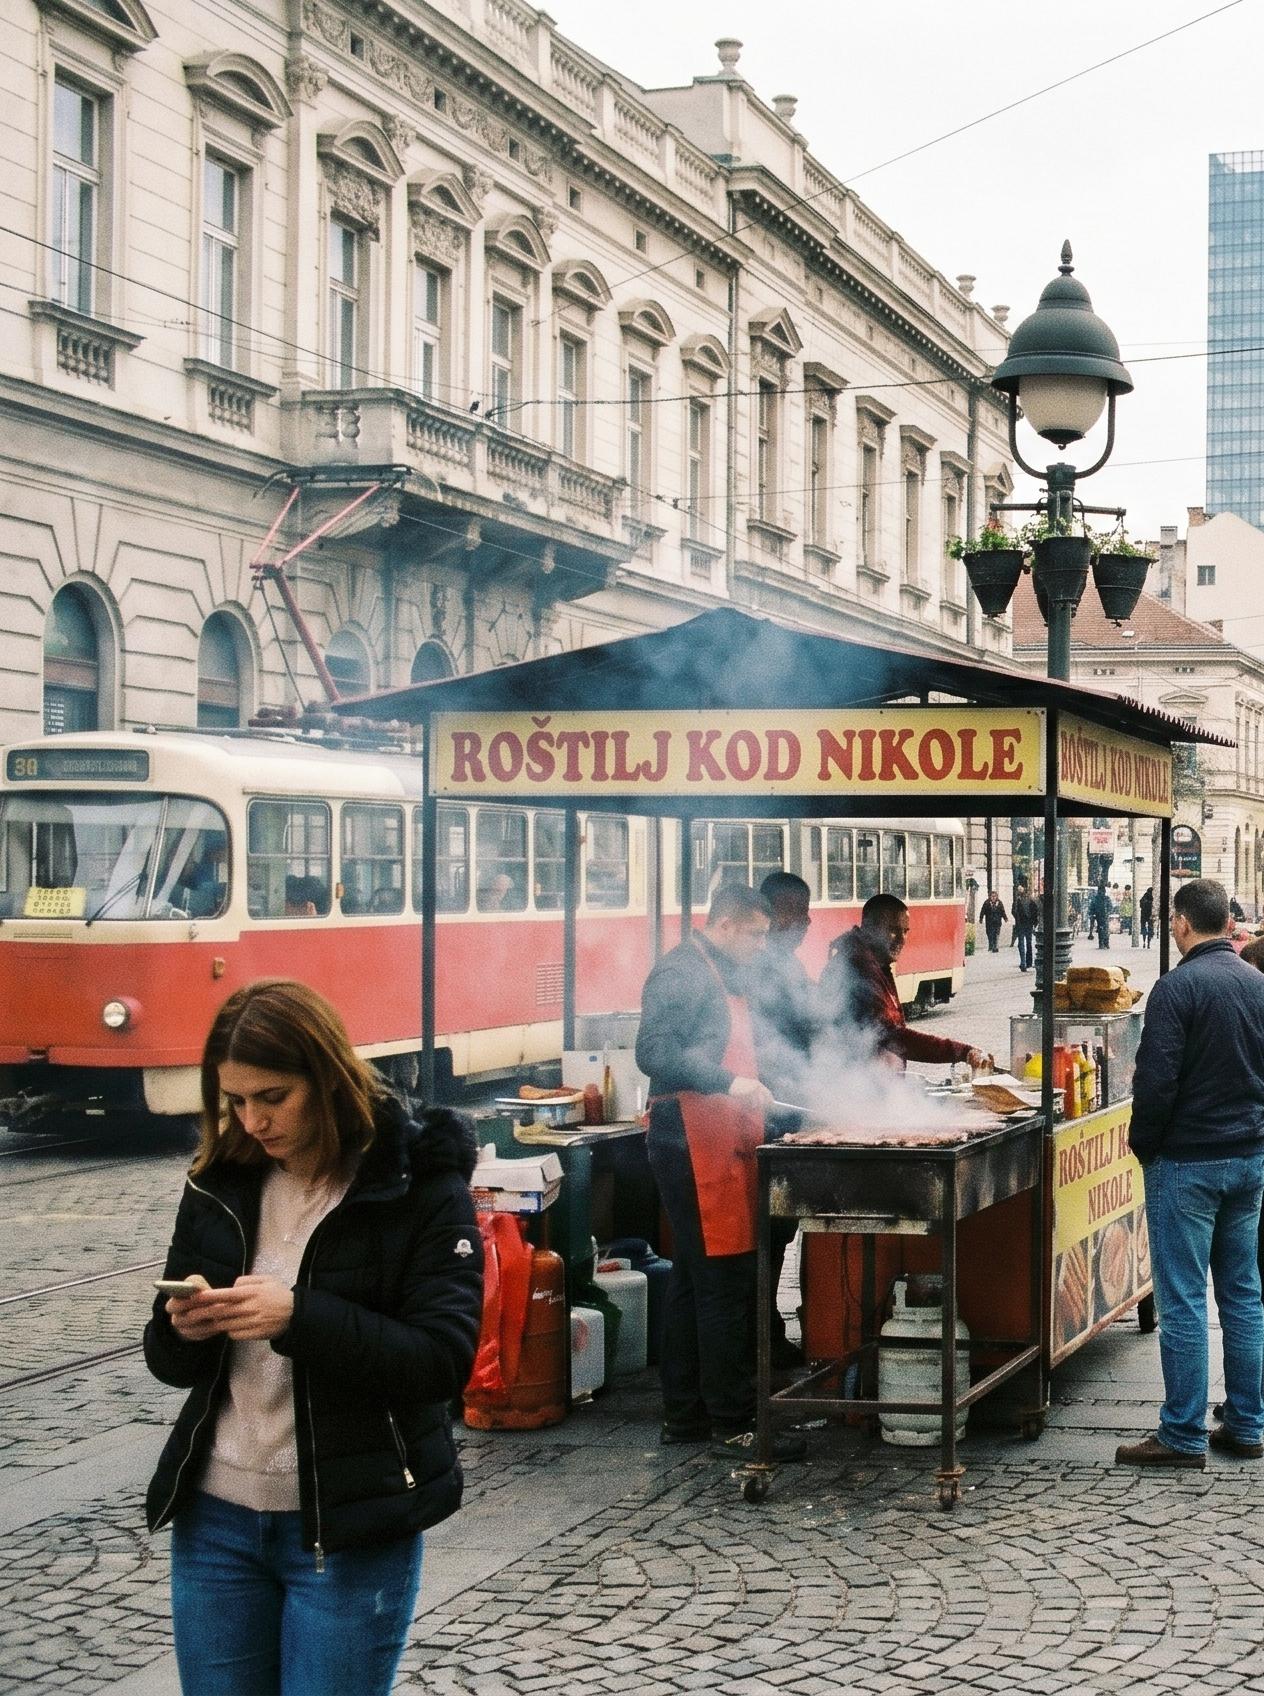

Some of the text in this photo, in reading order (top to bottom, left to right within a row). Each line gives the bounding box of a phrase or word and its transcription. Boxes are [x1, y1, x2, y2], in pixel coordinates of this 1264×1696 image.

[450, 715, 1024, 784] ROŠTILJ KOD NIKOLE
[1060, 725, 1169, 805] ROŠTILJ KOD NIKOLE
[1058, 1128, 1114, 1188] ROŠTILJ
[1087, 1168, 1133, 1226] NIKOLE
